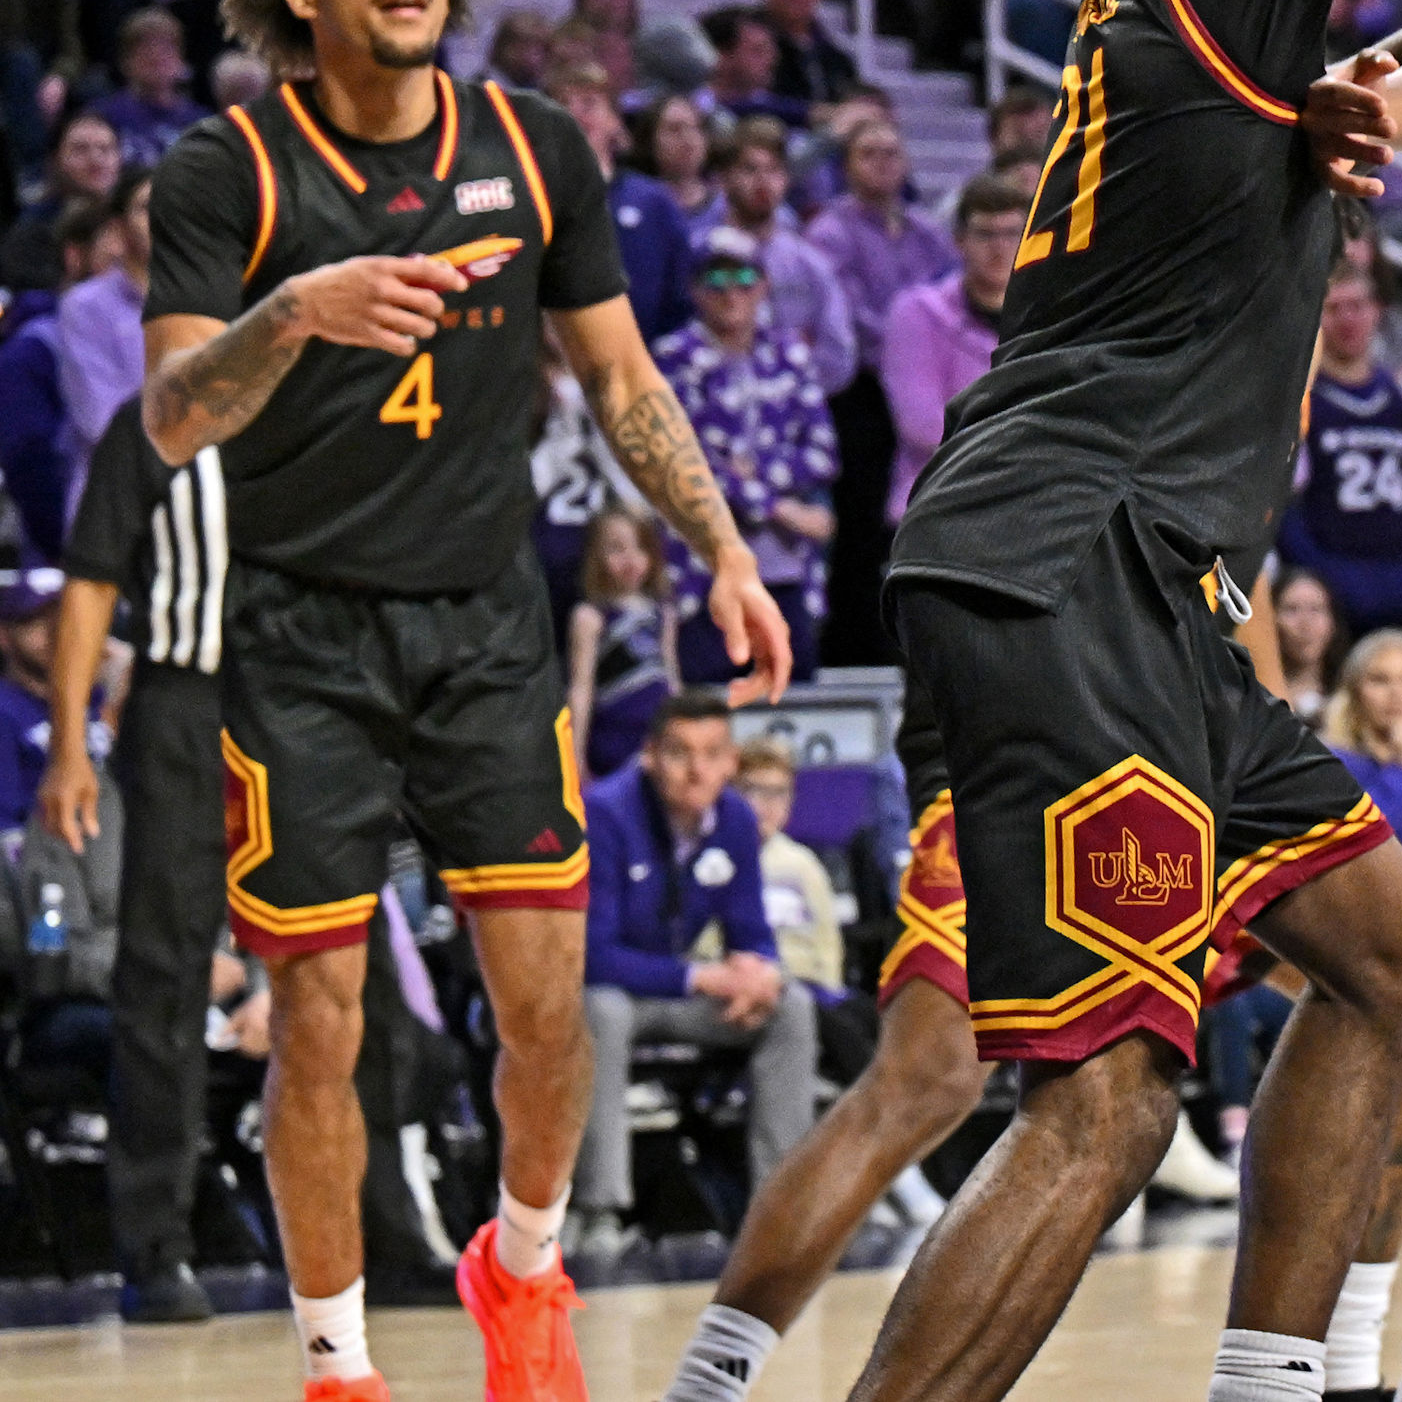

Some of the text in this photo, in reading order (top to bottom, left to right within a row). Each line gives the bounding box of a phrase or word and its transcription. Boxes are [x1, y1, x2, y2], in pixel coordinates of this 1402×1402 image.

[1013, 46, 1108, 271] 21
[379, 351, 443, 440] 4
[1088, 826, 1194, 906] ULM
